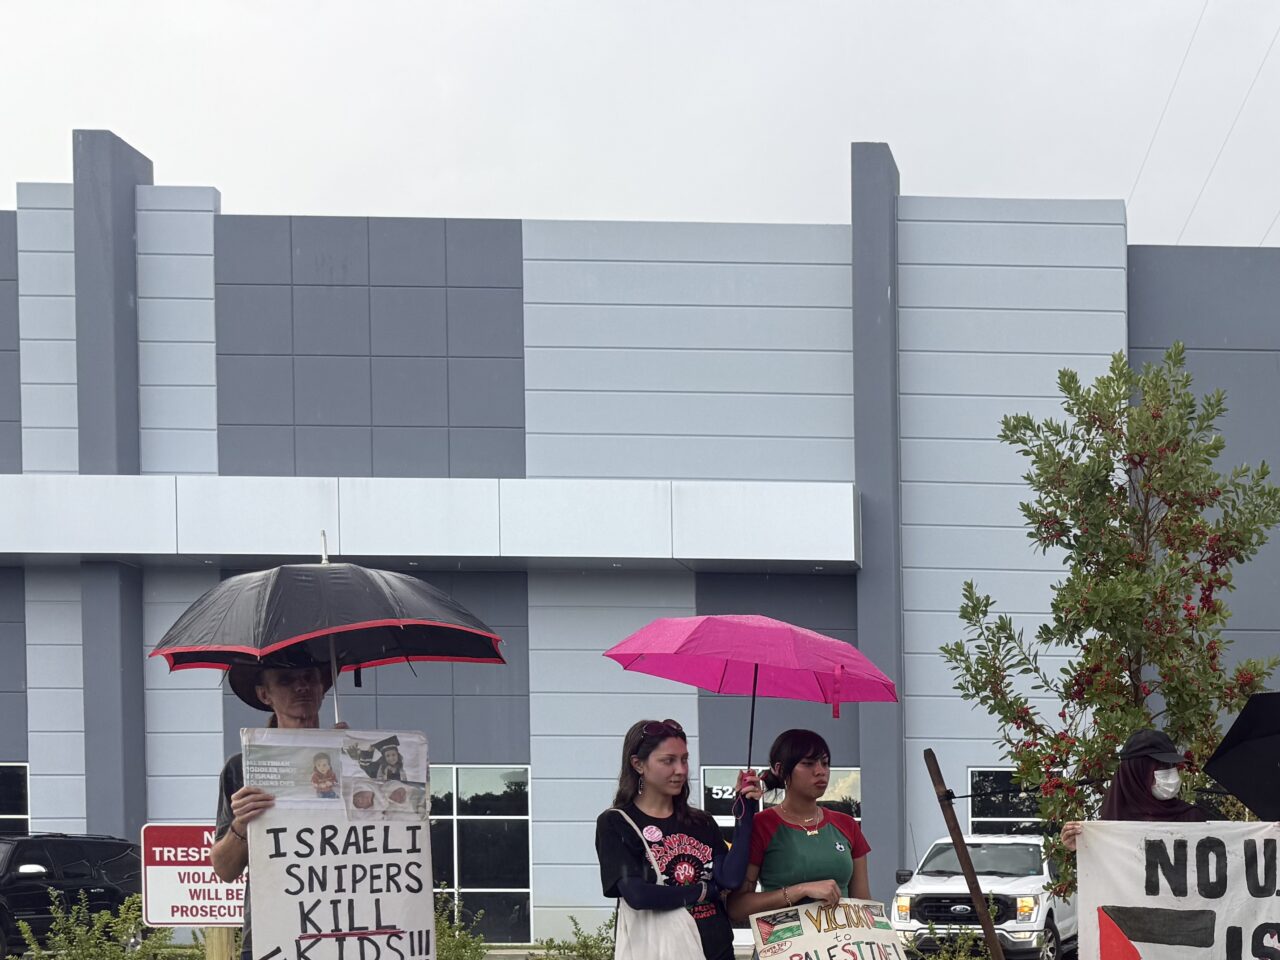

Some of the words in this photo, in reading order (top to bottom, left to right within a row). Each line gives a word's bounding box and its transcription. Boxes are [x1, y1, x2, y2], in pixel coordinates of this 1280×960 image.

[711, 786, 736, 799] 52
[203, 830, 215, 845] N
[266, 824, 422, 859] ISRAELI
[152, 847, 210, 861] TRESP
[662, 833, 713, 861] NATIONAL
[1144, 837, 1228, 898] NO
[284, 862, 423, 895] SNIPERS
[189, 889, 222, 900] WILL
[226, 889, 244, 900] BE
[171, 905, 244, 917] PROSECUT
[299, 898, 397, 934] KILL
[833, 932, 852, 943] to
